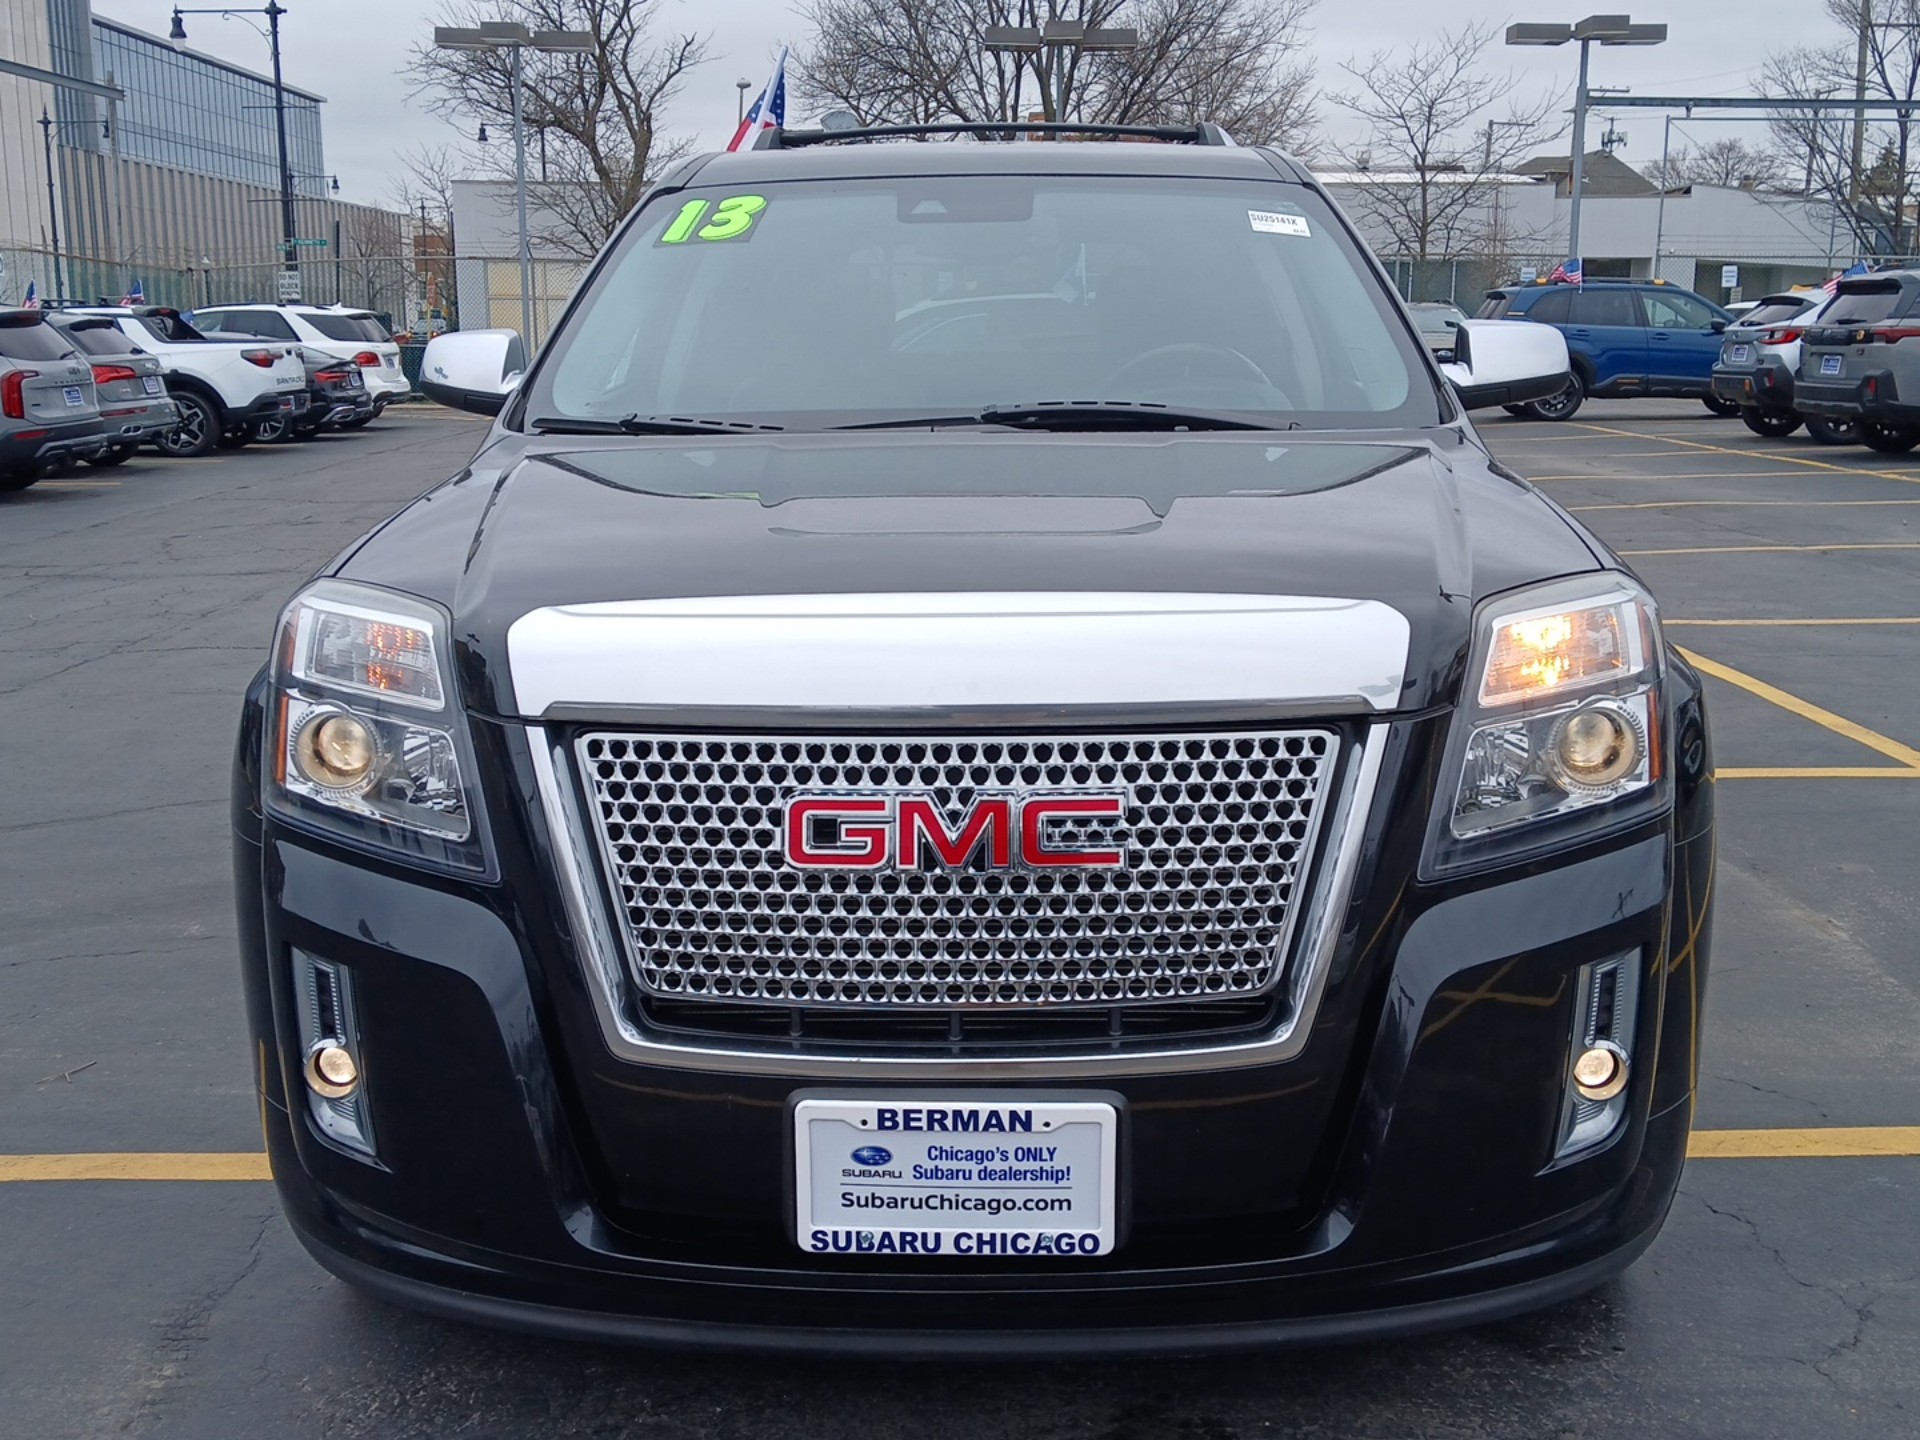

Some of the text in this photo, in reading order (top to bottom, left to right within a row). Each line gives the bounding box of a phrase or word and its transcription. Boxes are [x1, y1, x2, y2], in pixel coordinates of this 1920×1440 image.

[660, 194, 767, 243] 13
[1250, 213, 1298, 226] SU25141X
[784, 793, 1127, 869] GMC
[876, 1108, 1032, 1132] BERMAN
[927, 1145, 1057, 1165] Chicago's ONLY
[841, 1168, 902, 1179] SUBARU
[912, 1164, 1071, 1184] Subaru dealership!
[840, 1191, 1072, 1215] SubaruChicago.com
[810, 1230, 1100, 1254] SUBARU CHICAGO
